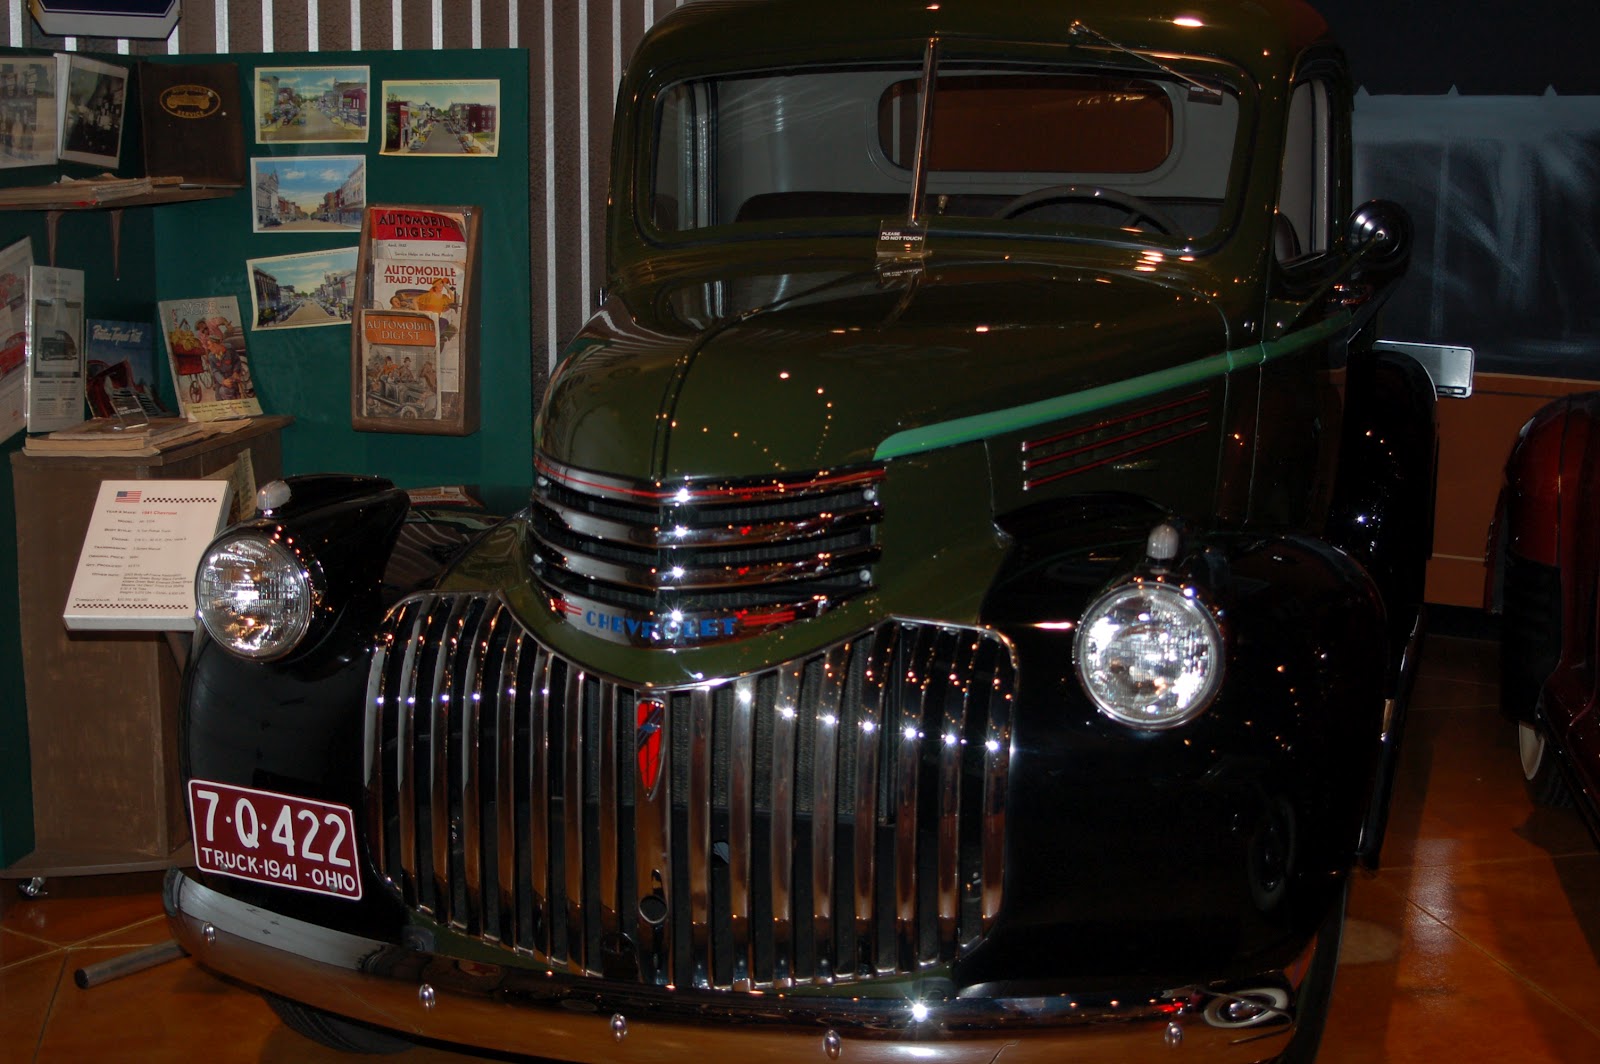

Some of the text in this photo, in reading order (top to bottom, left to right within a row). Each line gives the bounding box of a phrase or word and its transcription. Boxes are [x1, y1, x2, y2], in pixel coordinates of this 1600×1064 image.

[378, 213, 457, 229] AUTOMOBILE
[395, 227, 442, 238] DIGEST
[384, 264, 457, 277] AUTOMOBILE
[384, 275, 413, 284] TRADE
[366, 320, 434, 332] AUTOMOBILE
[381, 331, 421, 341] DIGEST
[586, 610, 739, 638] CHEVROLET
